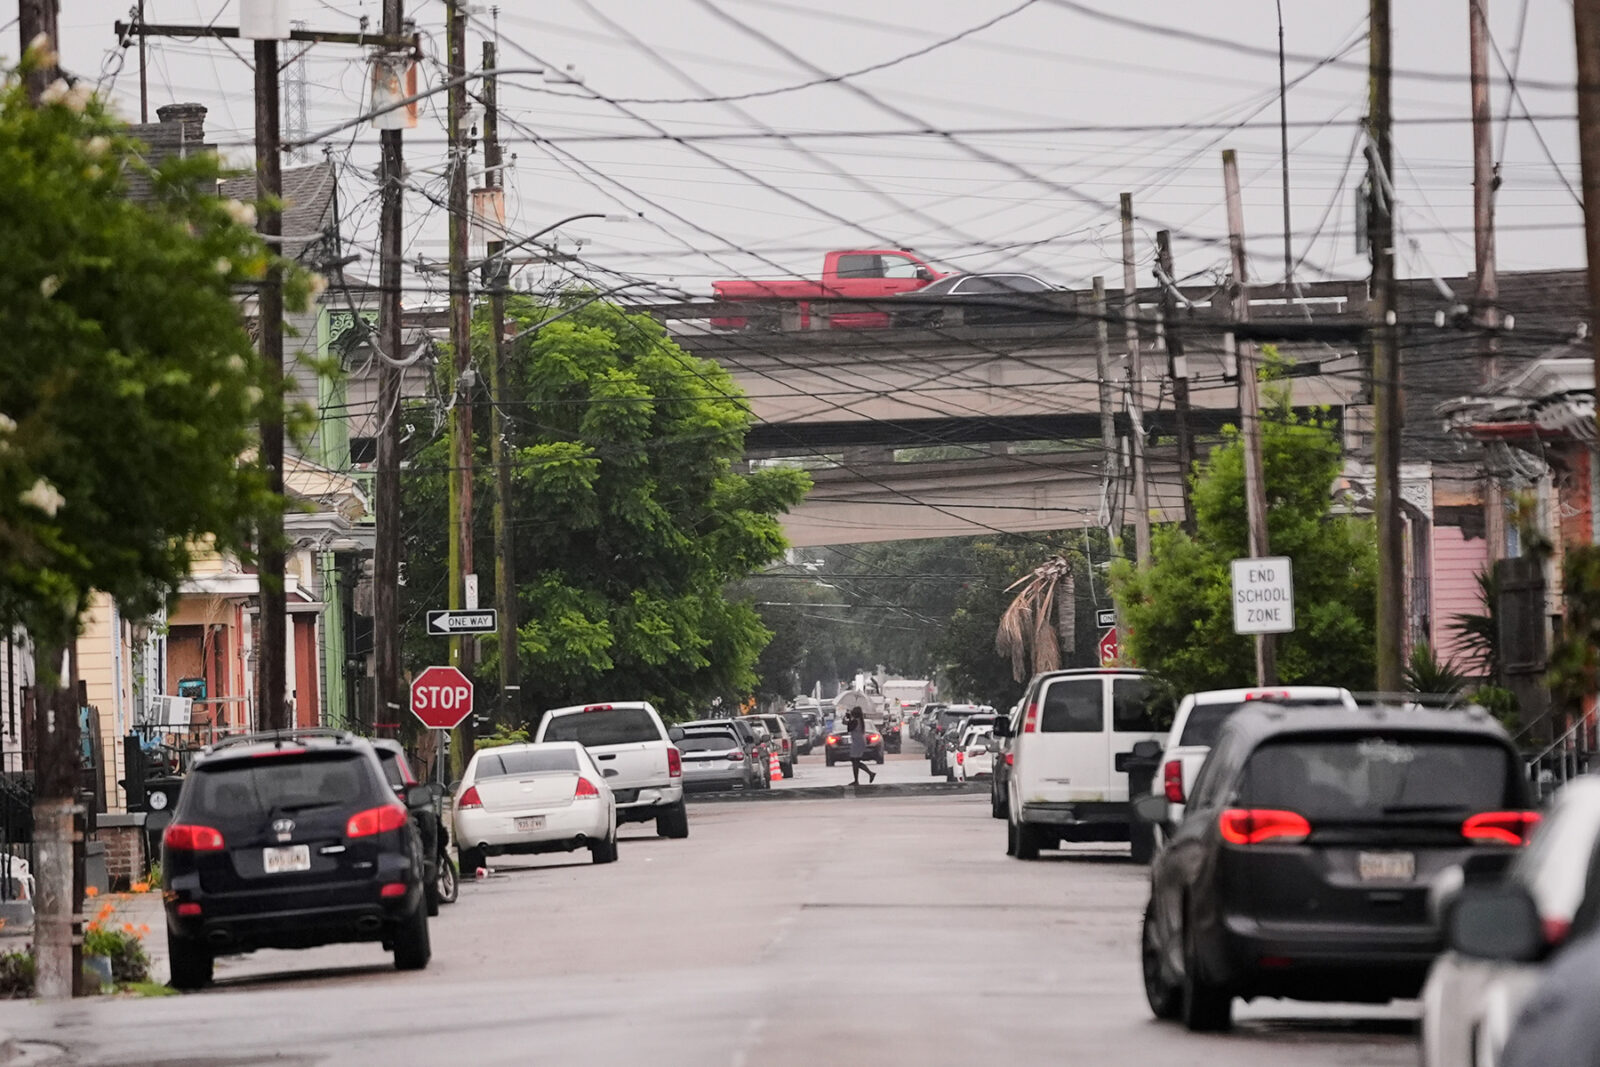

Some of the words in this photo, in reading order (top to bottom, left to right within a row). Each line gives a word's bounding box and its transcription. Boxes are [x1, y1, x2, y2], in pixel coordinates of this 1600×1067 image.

[1249, 569, 1275, 583] END
[1237, 587, 1289, 603] SCHOOL
[448, 617, 467, 627] ONE
[470, 616, 488, 626] WAY
[1247, 608, 1282, 623] ZONE
[415, 686, 469, 709] STOP
